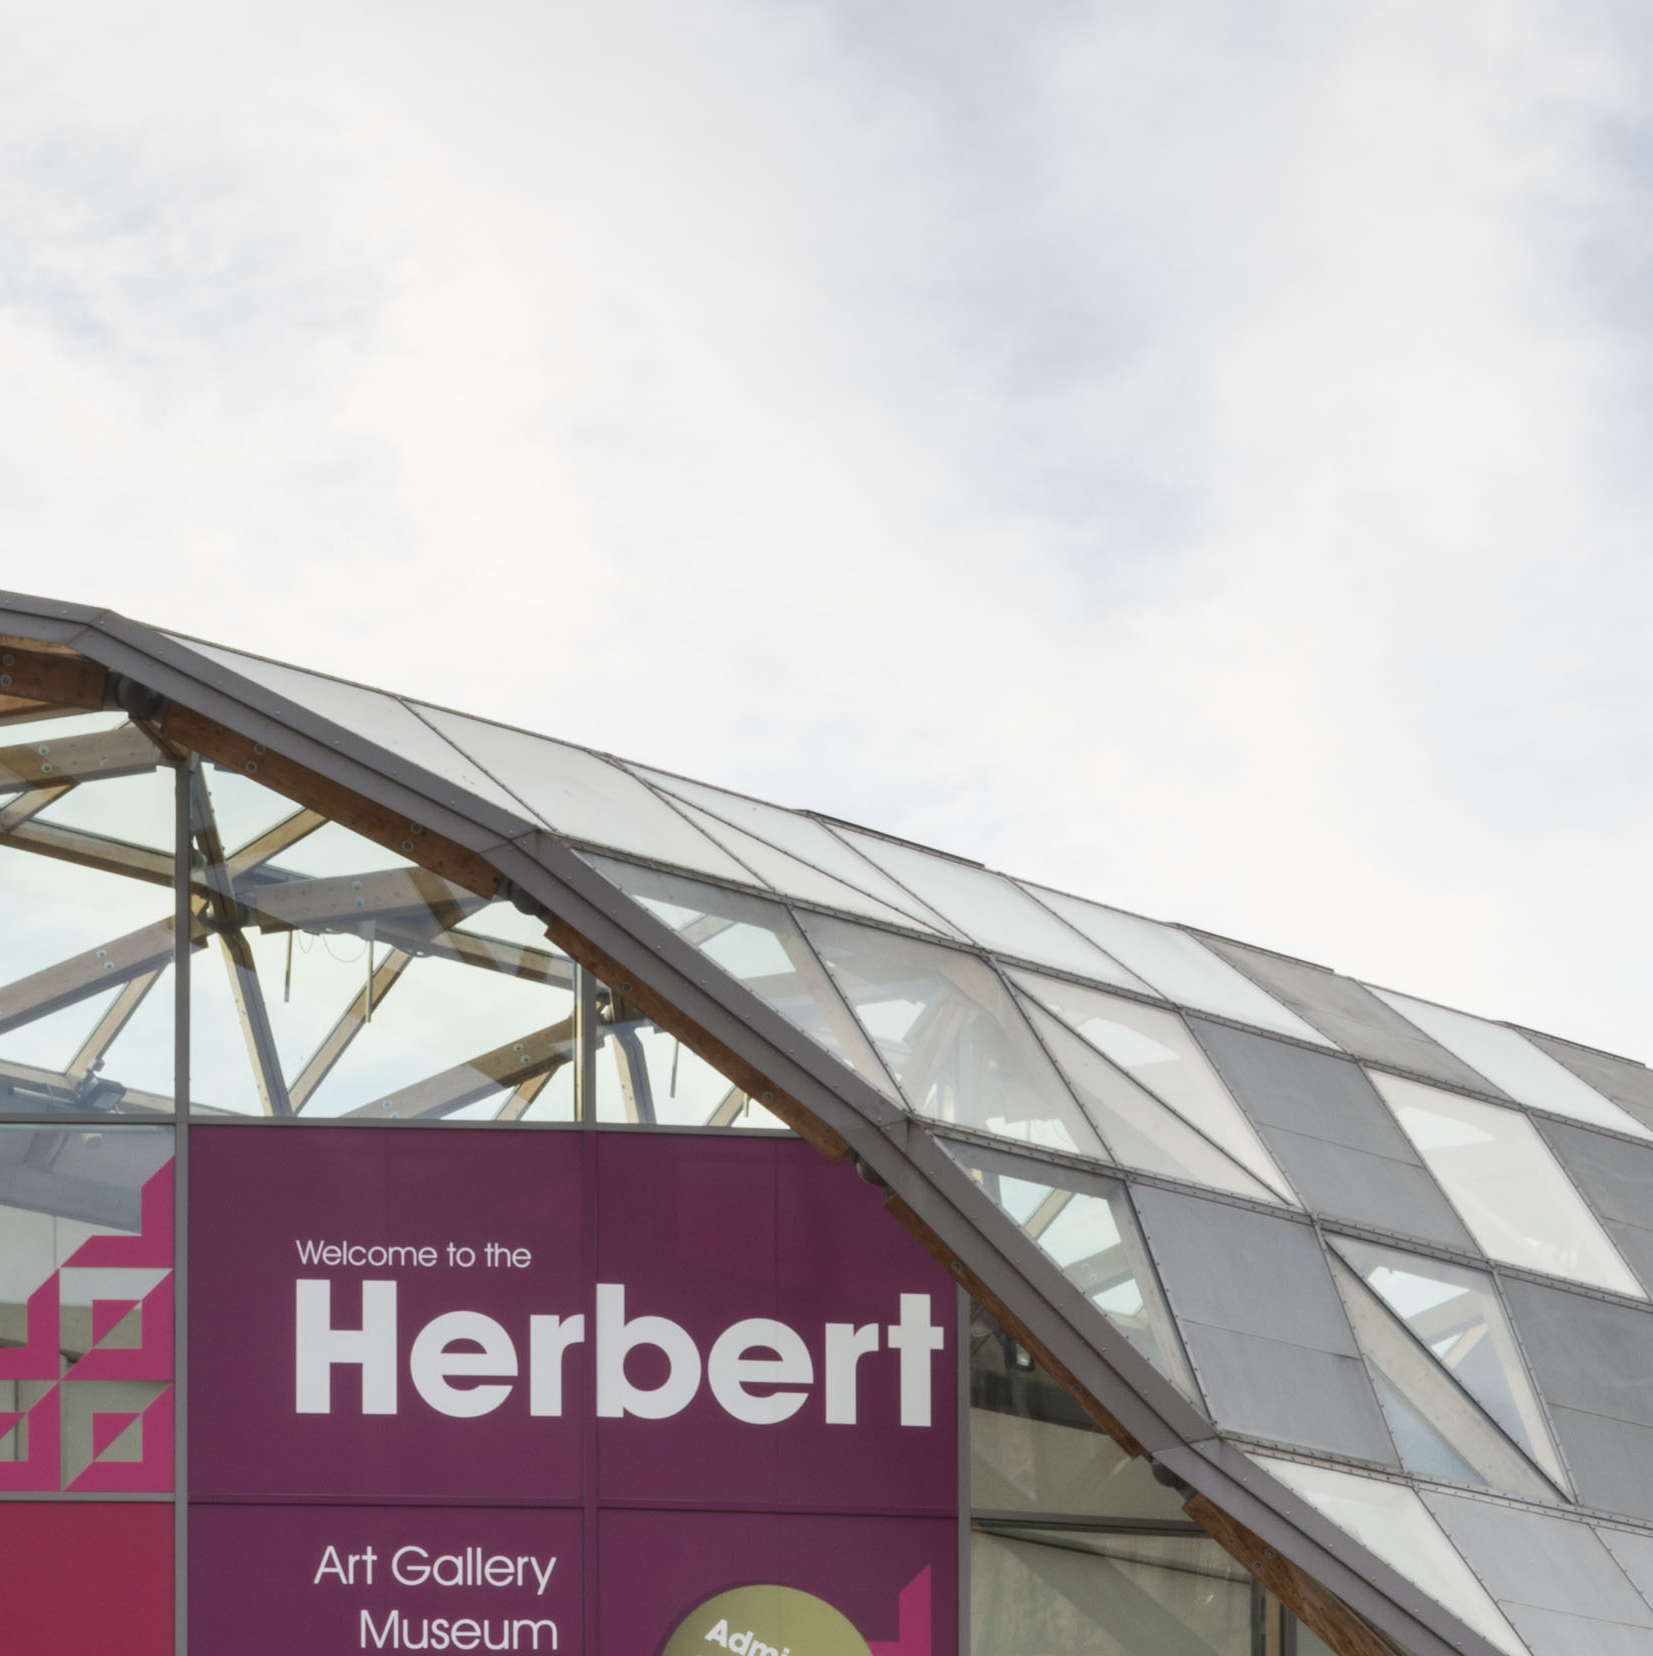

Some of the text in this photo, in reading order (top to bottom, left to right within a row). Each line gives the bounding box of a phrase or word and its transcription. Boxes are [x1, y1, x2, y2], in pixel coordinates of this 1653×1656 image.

[296, 1239, 532, 1269] Welcome to the
[295, 1279, 944, 1427] Herbert
[313, 1545, 556, 1595] Art Gallery
[359, 1610, 558, 1651] Museum
